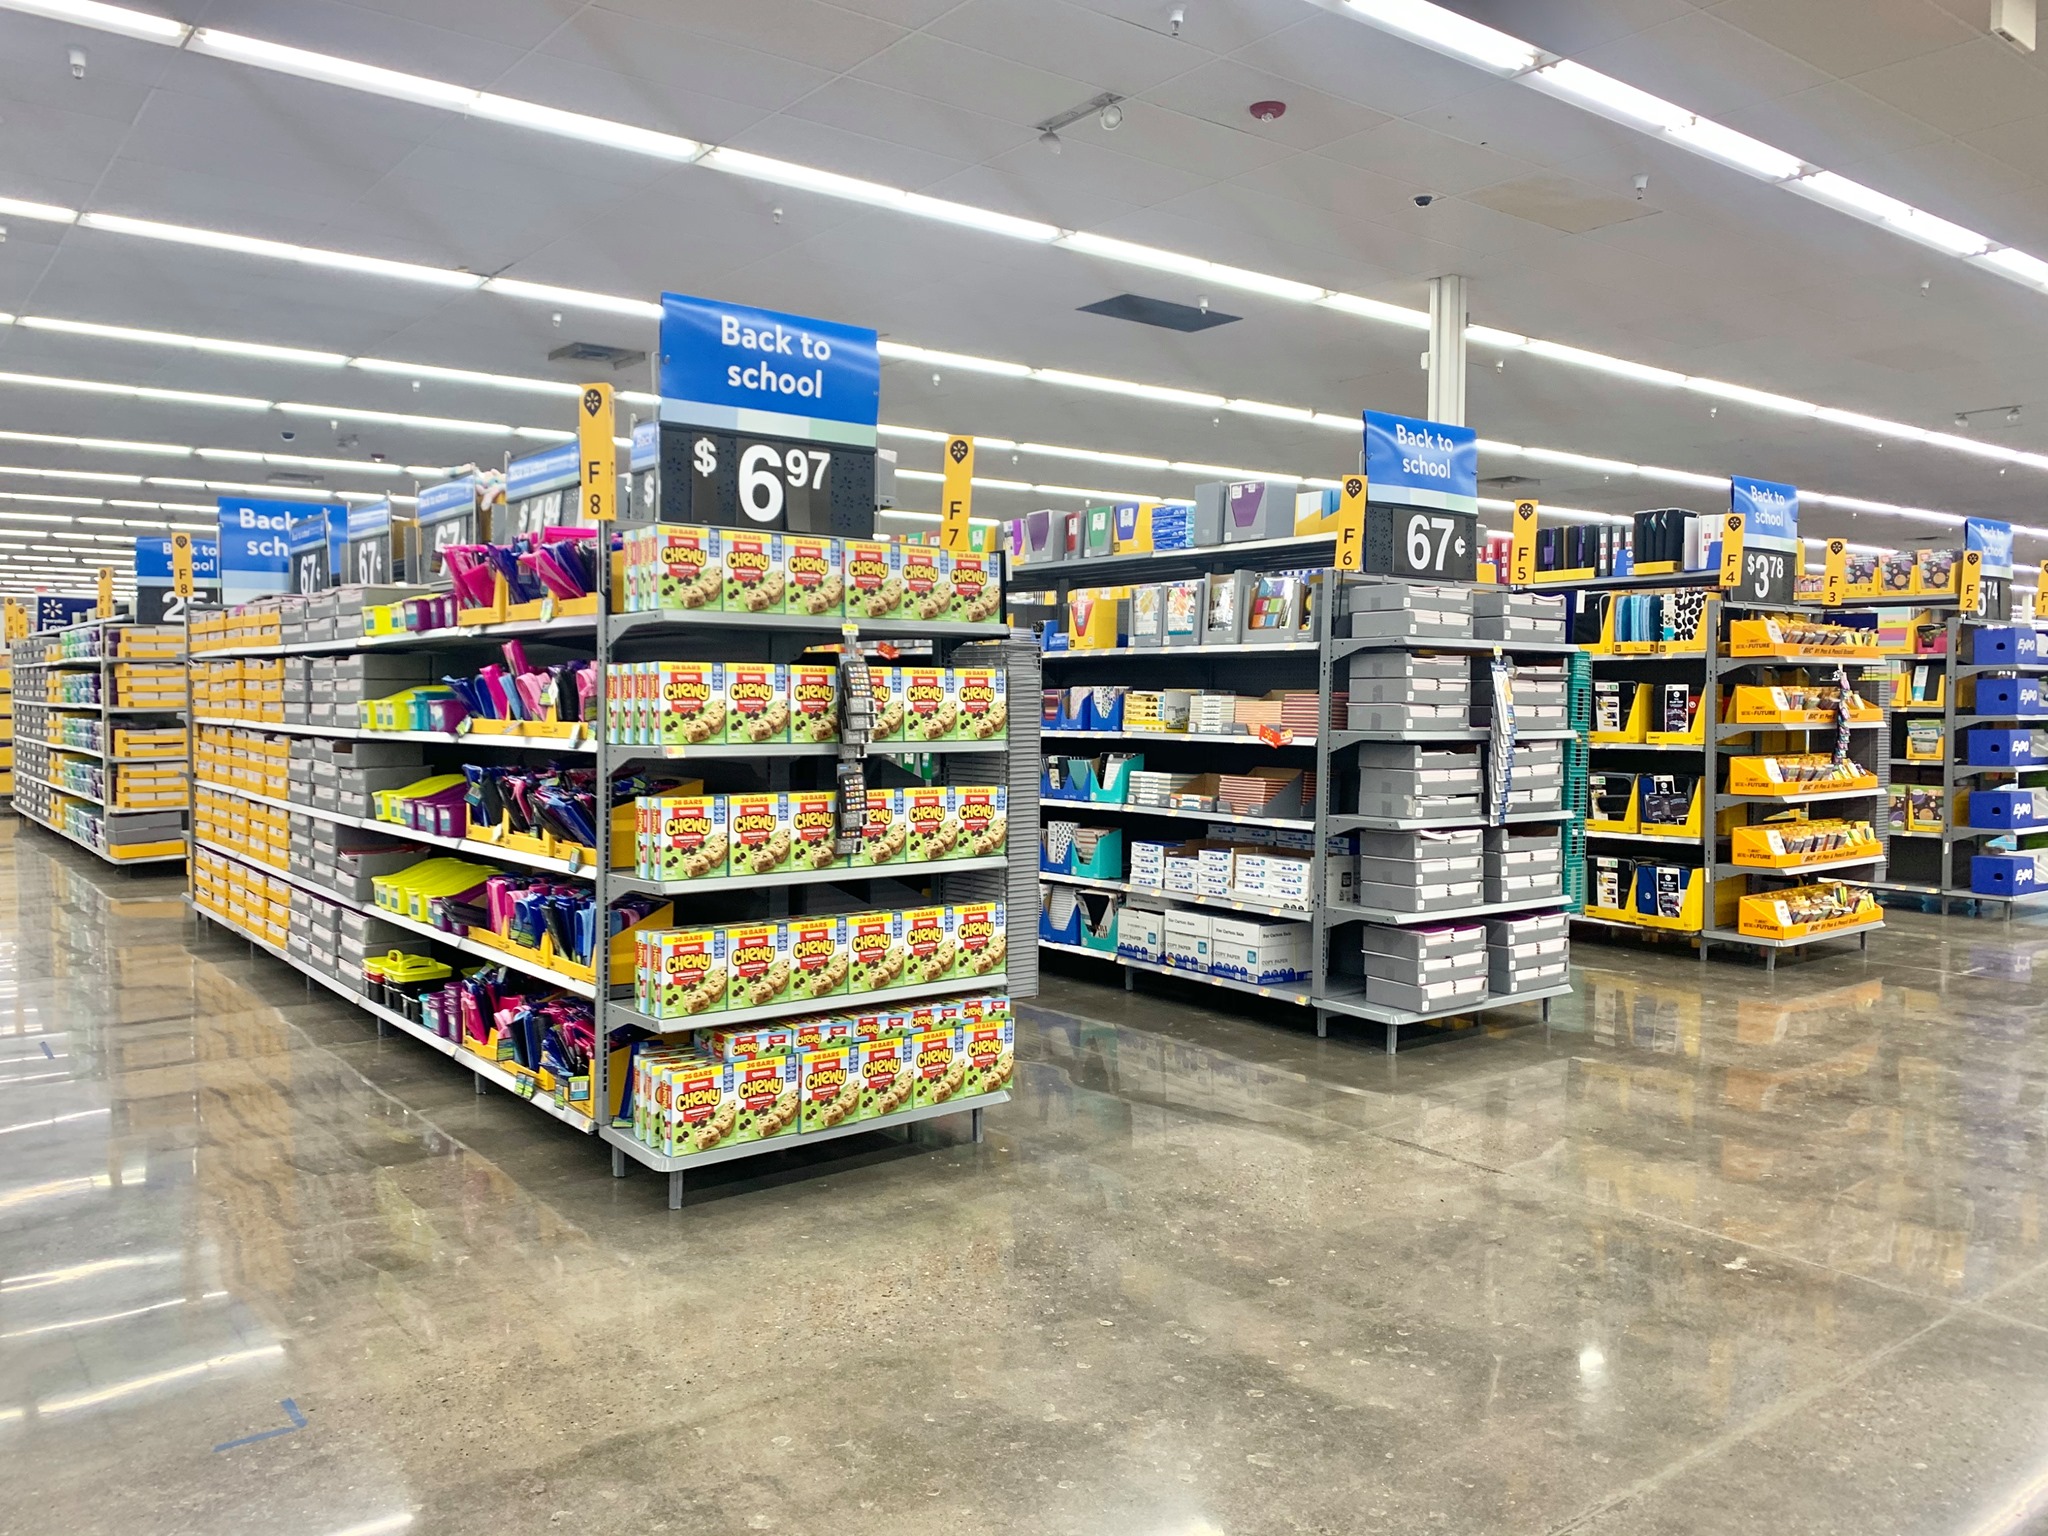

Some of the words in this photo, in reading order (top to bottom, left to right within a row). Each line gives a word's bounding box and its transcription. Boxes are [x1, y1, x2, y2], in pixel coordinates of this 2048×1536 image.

[721, 315, 792, 355] Back
[801, 332, 831, 360] to
[727, 361, 822, 398] school
[1396, 424, 1433, 448] Back
[1438, 433, 1453, 452] to
[589, 462, 600, 483] F
[1403, 456, 1450, 478] school
[590, 494, 600, 514] 8
[1750, 486, 1773, 504] Back
[1775, 491, 1784, 505] to
[240, 508, 299, 531] Back
[950, 501, 962, 520] F
[1755, 508, 1783, 526] school
[949, 529, 959, 546] 7
[1344, 529, 1355, 544] F
[201, 544, 218, 556] to
[662, 546, 706, 567] CHEWY
[1343, 551, 1352, 565] 6
[1518, 548, 1528, 561] F
[727, 551, 769, 571] CHEWY
[789, 556, 828, 575] CHEWY
[850, 560, 888, 578] CHEWY
[1727, 555, 1736, 566] F
[179, 569, 187, 580] F
[903, 565, 938, 582] CHEWY
[951, 569, 987, 585] CHEWY
[1517, 567, 1526, 580] 5
[1726, 572, 1735, 582] 4
[1829, 576, 1838, 587] F
[180, 584, 188, 594] 8
[1829, 592, 1836, 602] 3
[1966, 585, 1974, 594] F
[2041, 592, 2048, 601] F
[1966, 599, 1973, 608] 2
[664, 682, 710, 701] CHEWY
[730, 683, 772, 700] CHEWY
[795, 685, 834, 702] CHEWY
[907, 685, 944, 702] CHEWY
[959, 686, 994, 702] CHEWY
[794, 812, 834, 830] CHEWY
[909, 806, 945, 823] CHEWY
[959, 805, 995, 821] CHEWY
[665, 817, 711, 836] CHEWY
[734, 814, 776, 833] CHEWY
[907, 927, 943, 945] CHEWY
[958, 921, 994, 939] CHEWY
[793, 937, 836, 958] CHEWY
[852, 933, 891, 952] CHEWY
[666, 952, 712, 973] CHEWY
[732, 945, 775, 966] CHEWY
[968, 1039, 1002, 1057] CHEWY
[916, 1048, 953, 1068] CHEWY
[863, 1058, 901, 1077] CHEWY
[739, 1077, 783, 1099] CHEWY
[806, 1068, 846, 1090] CHEWY
[676, 1087, 721, 1112] CHEWY
